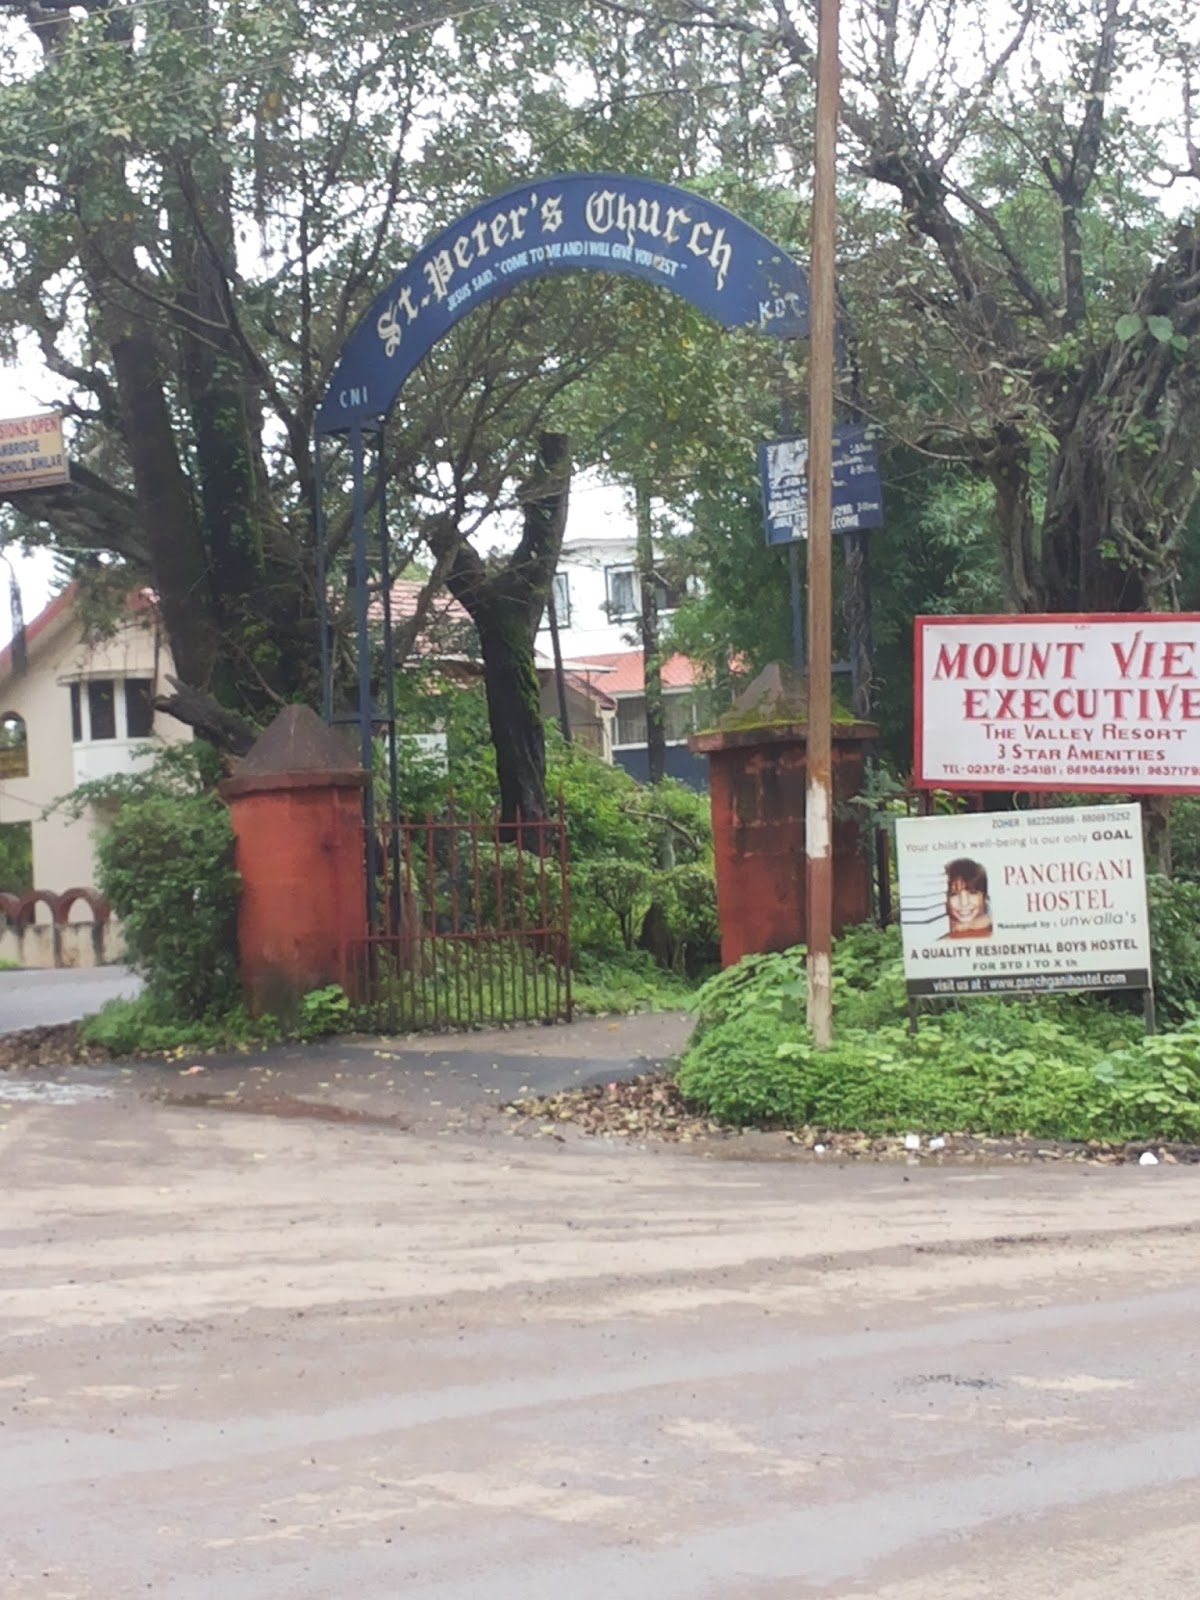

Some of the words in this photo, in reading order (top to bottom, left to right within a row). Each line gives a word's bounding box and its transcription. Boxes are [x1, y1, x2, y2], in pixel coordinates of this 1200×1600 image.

[585, 190, 732, 292] Church
[447, 282, 472, 311] JESUS
[529, 247, 546, 264] TO
[546, 244, 561, 258] ME
[562, 241, 583, 257] AND
[583, 241, 589, 256] I
[589, 241, 610, 257] WILL
[611, 243, 632, 263] GIVE
[634, 247, 652, 266] YOU
[339, 386, 369, 409] CNI
[31, 417, 58, 435] OPEN
[932, 642, 1085, 680] MOUNT
[1111, 630, 1197, 680] VIE
[962, 684, 1200, 721] EXECUTIVE
[998, 744, 1006, 760] 3
[1092, 829, 1133, 841] GOAL
[1003, 858, 1134, 886] PANCHGANI
[1026, 889, 1115, 913] HOSTEL
[911, 949, 919, 960] A
[922, 946, 971, 959] QUALITY
[976, 943, 1053, 957] RESIDENTIAL
[1056, 941, 1087, 953] BOYS
[1091, 939, 1138, 951] HOSTEL
[973, 962, 996, 972] FOR
[1000, 961, 1023, 970] STD
[1035, 959, 1050, 969] TO
[1054, 959, 1063, 968] X
[957, 981, 969, 991] us
[970, 978, 981, 991] at
